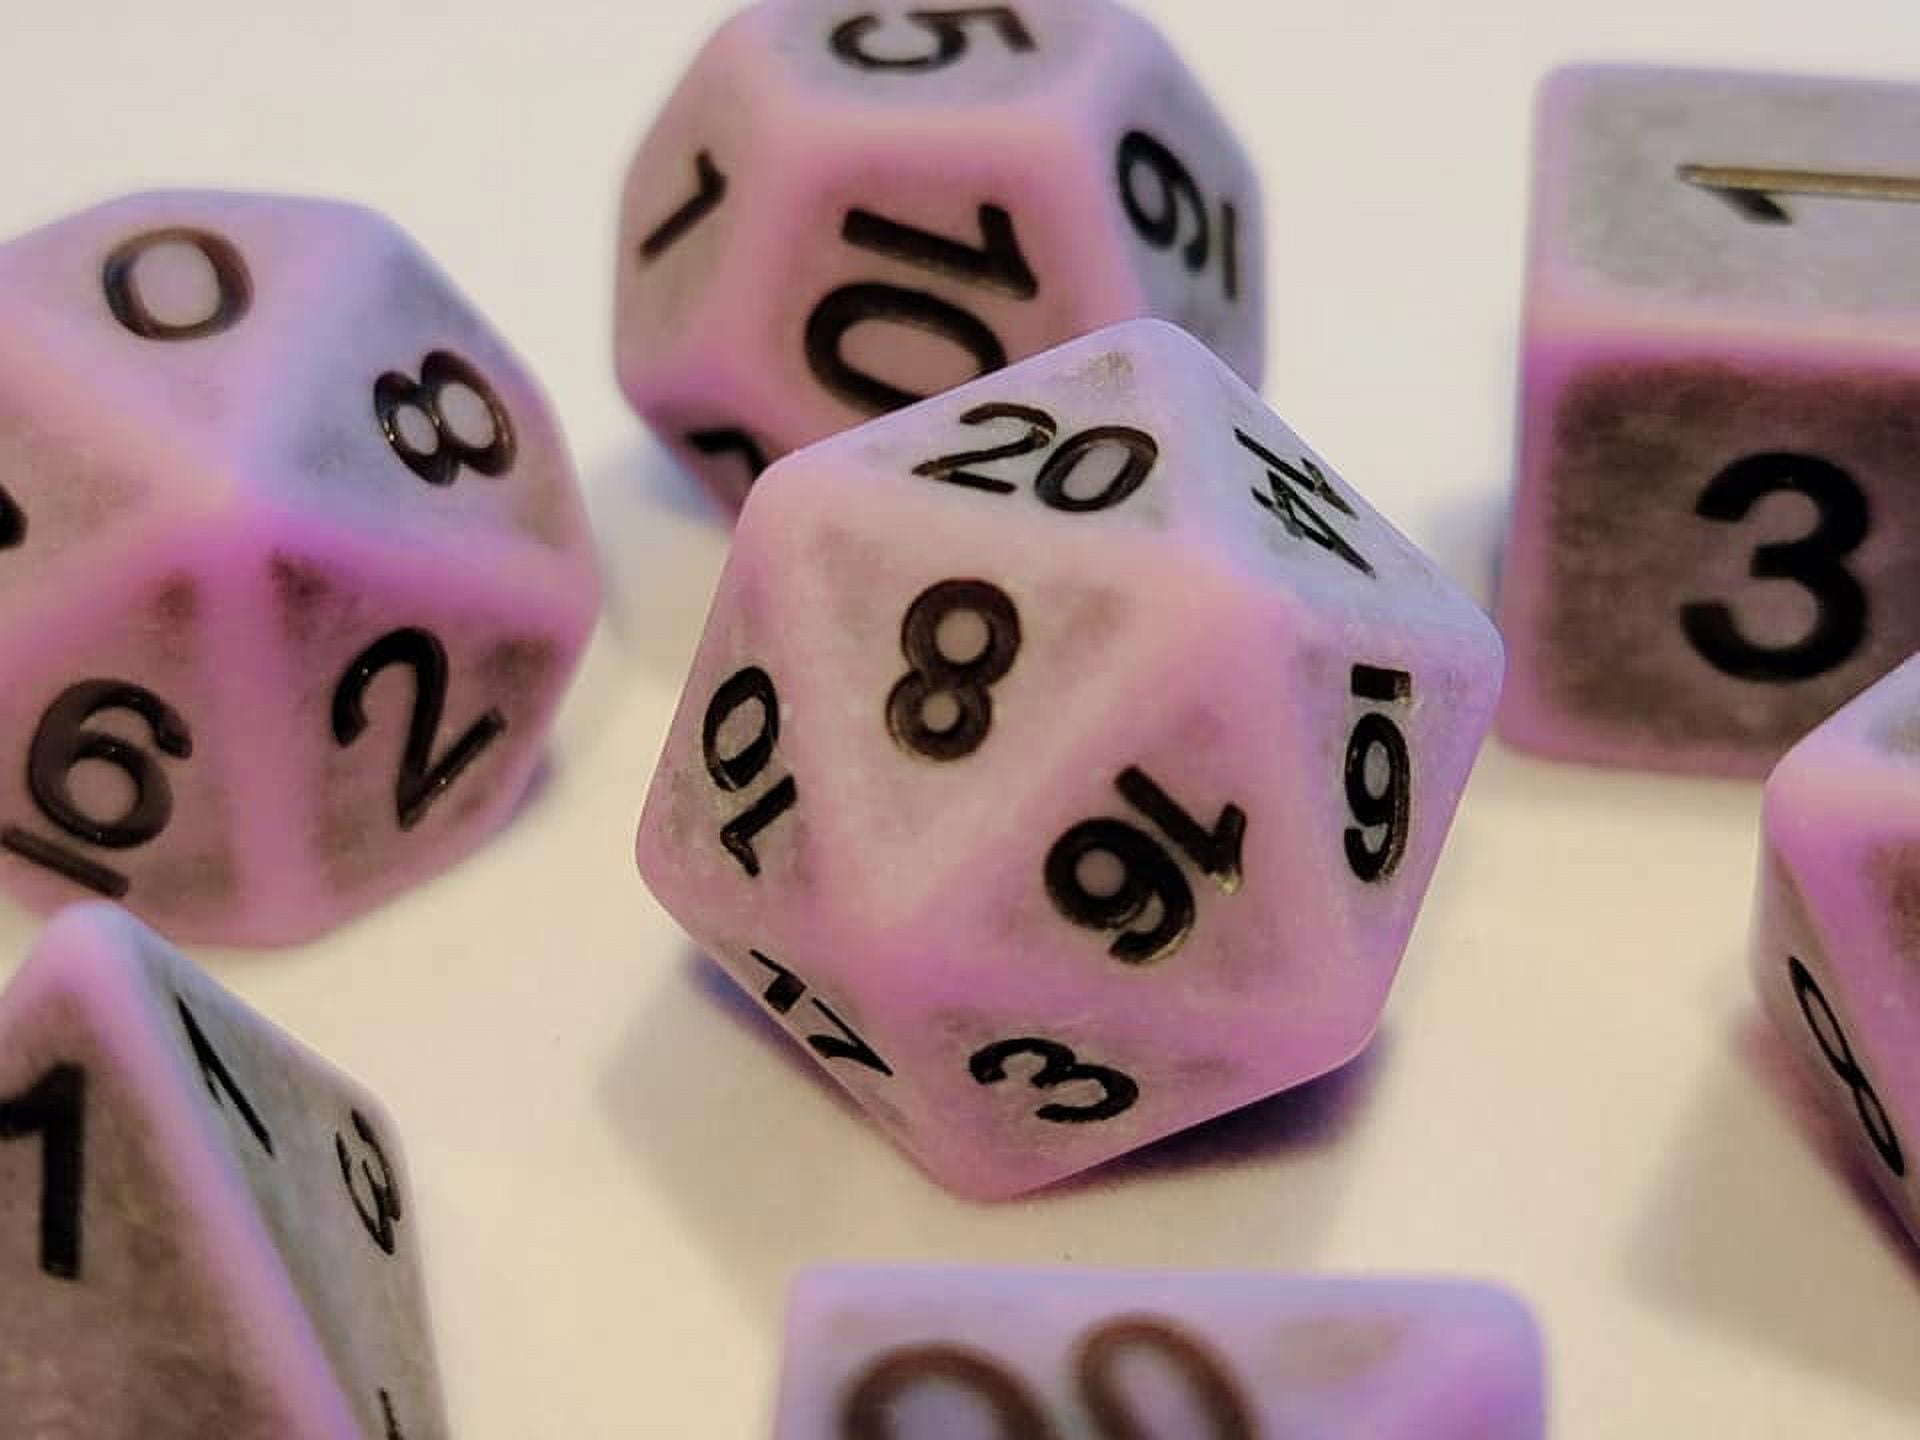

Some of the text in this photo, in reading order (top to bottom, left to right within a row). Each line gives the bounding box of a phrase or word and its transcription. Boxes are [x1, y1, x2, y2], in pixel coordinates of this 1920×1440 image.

[829, 4, 1037, 72] 5
[102, 227, 254, 341] 0
[804, 202, 1039, 412] 10
[372, 350, 517, 485] 8
[911, 402, 1159, 513] 20
[1234, 427, 1377, 579] 14
[1678, 453, 1870, 682] 3
[331, 628, 507, 833] 2
[885, 578, 1021, 761] 8
[702, 666, 798, 877] 10
[1043, 765, 1248, 965] 16
[175, 992, 276, 1158] 1
[750, 948, 894, 1077] 17
[968, 1037, 1139, 1123] 3
[1788, 955, 1906, 1176] 8
[0, 1060, 85, 1281] 1
[335, 1108, 402, 1256] 3
